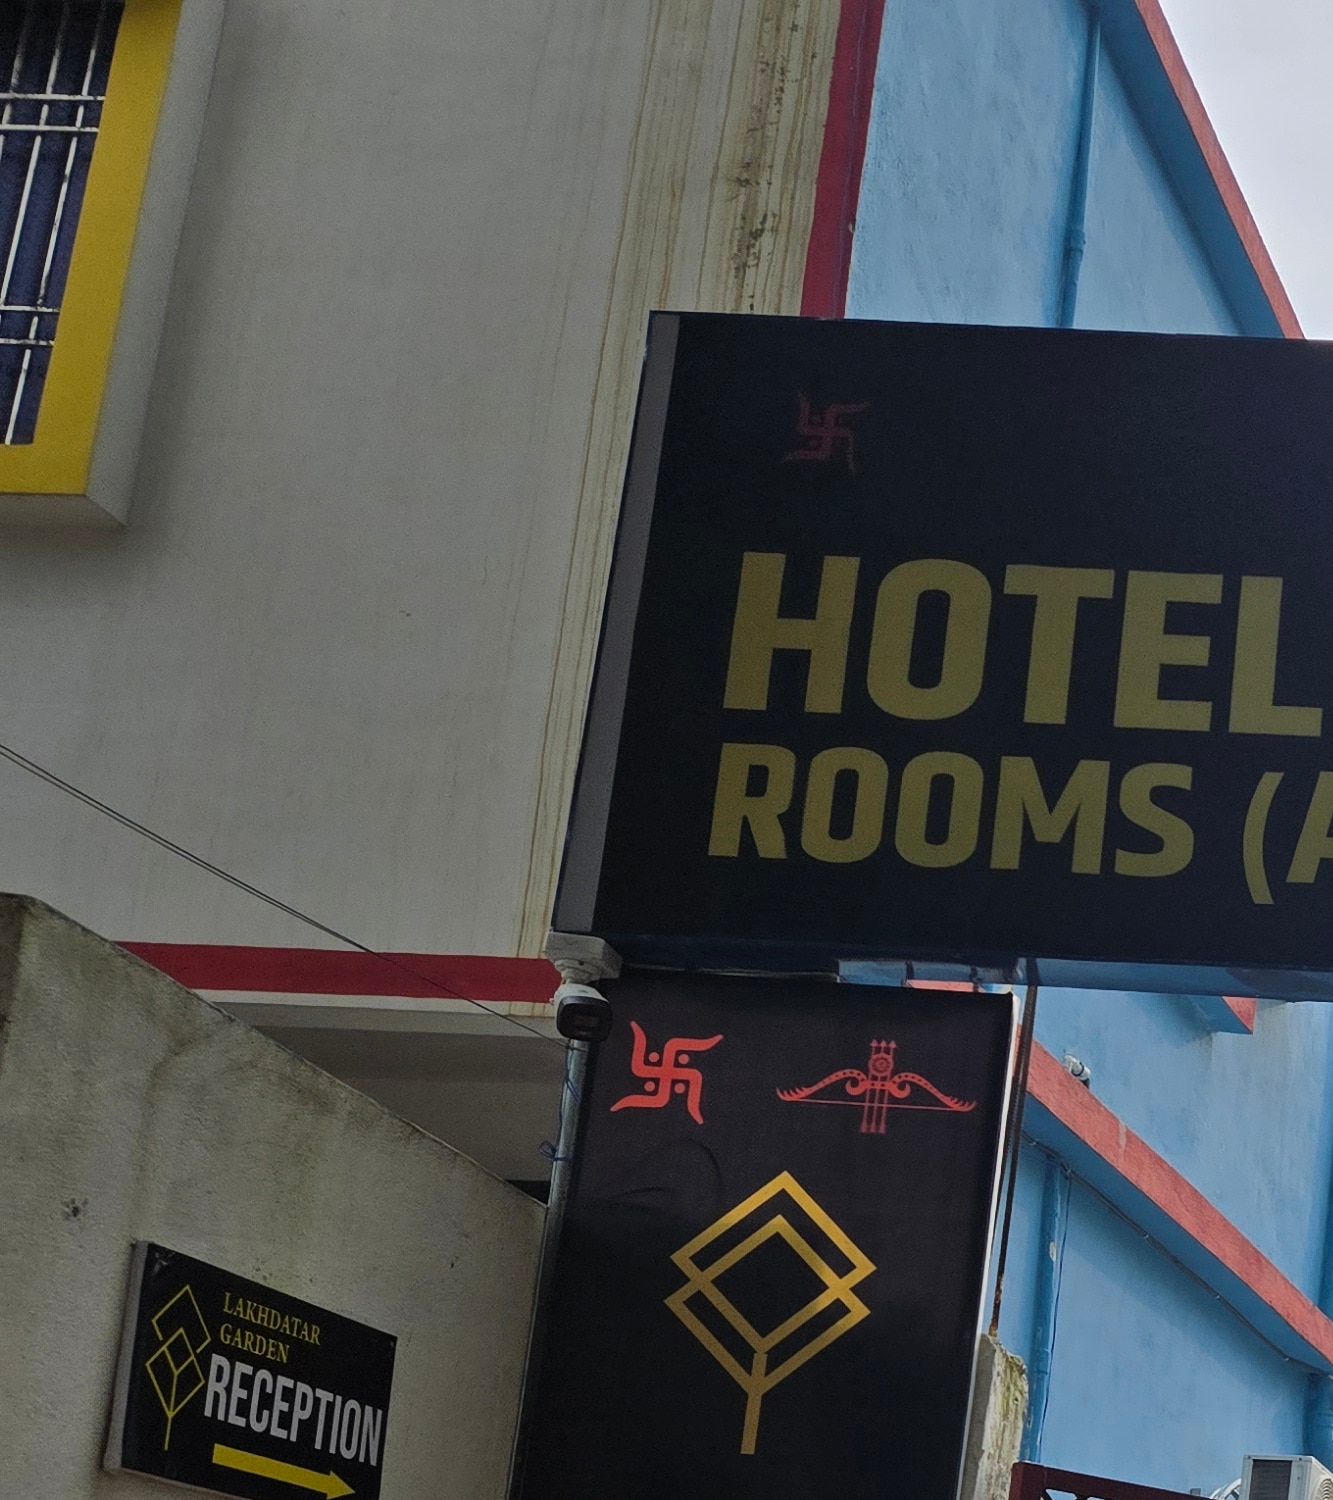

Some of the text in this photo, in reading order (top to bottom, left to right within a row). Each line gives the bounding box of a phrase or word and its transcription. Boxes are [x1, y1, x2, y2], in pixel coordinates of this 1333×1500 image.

[720, 548, 1325, 740] HOTEL
[706, 740, 1196, 880] ROOMS
[219, 1323, 290, 1364] GARDEN
[222, 1292, 322, 1346] LAKHDATAR
[203, 1353, 383, 1467] RECEPTION
